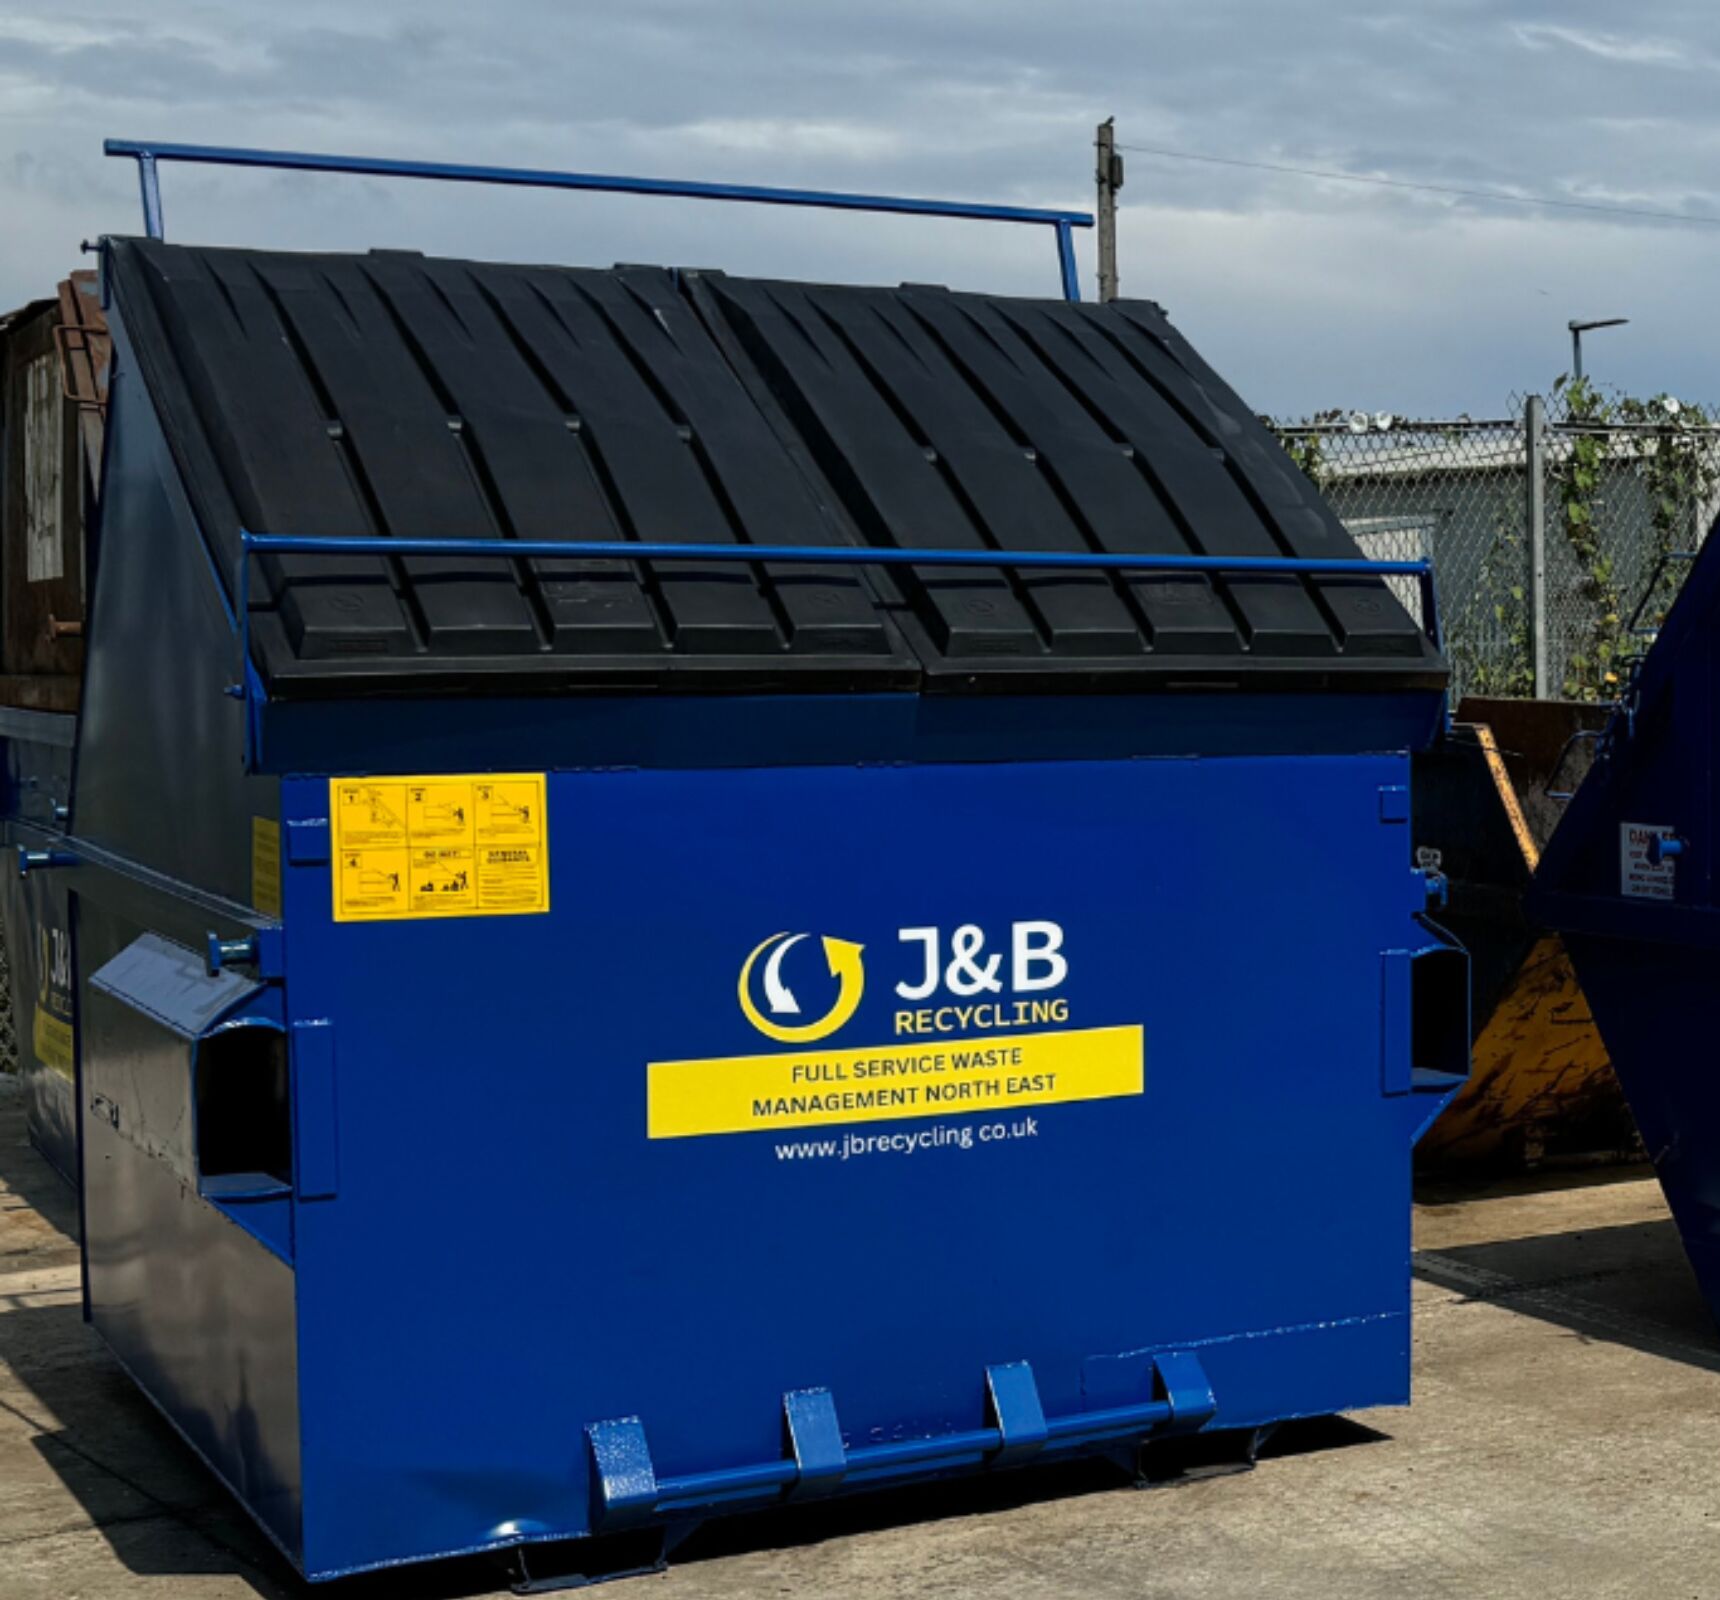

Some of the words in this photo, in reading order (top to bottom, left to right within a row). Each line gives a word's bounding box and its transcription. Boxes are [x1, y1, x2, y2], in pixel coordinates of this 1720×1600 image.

[894, 920, 1069, 1000] J&B
[894, 999, 1069, 1036] RECYCLING
[791, 1061, 848, 1084] FULL
[852, 1053, 947, 1080] SERVICE
[950, 1047, 1022, 1073] WASTE
[752, 1086, 919, 1117] MANAGEMENT
[925, 1078, 1001, 1103] NORTH
[1006, 1073, 1057, 1095] EAST
